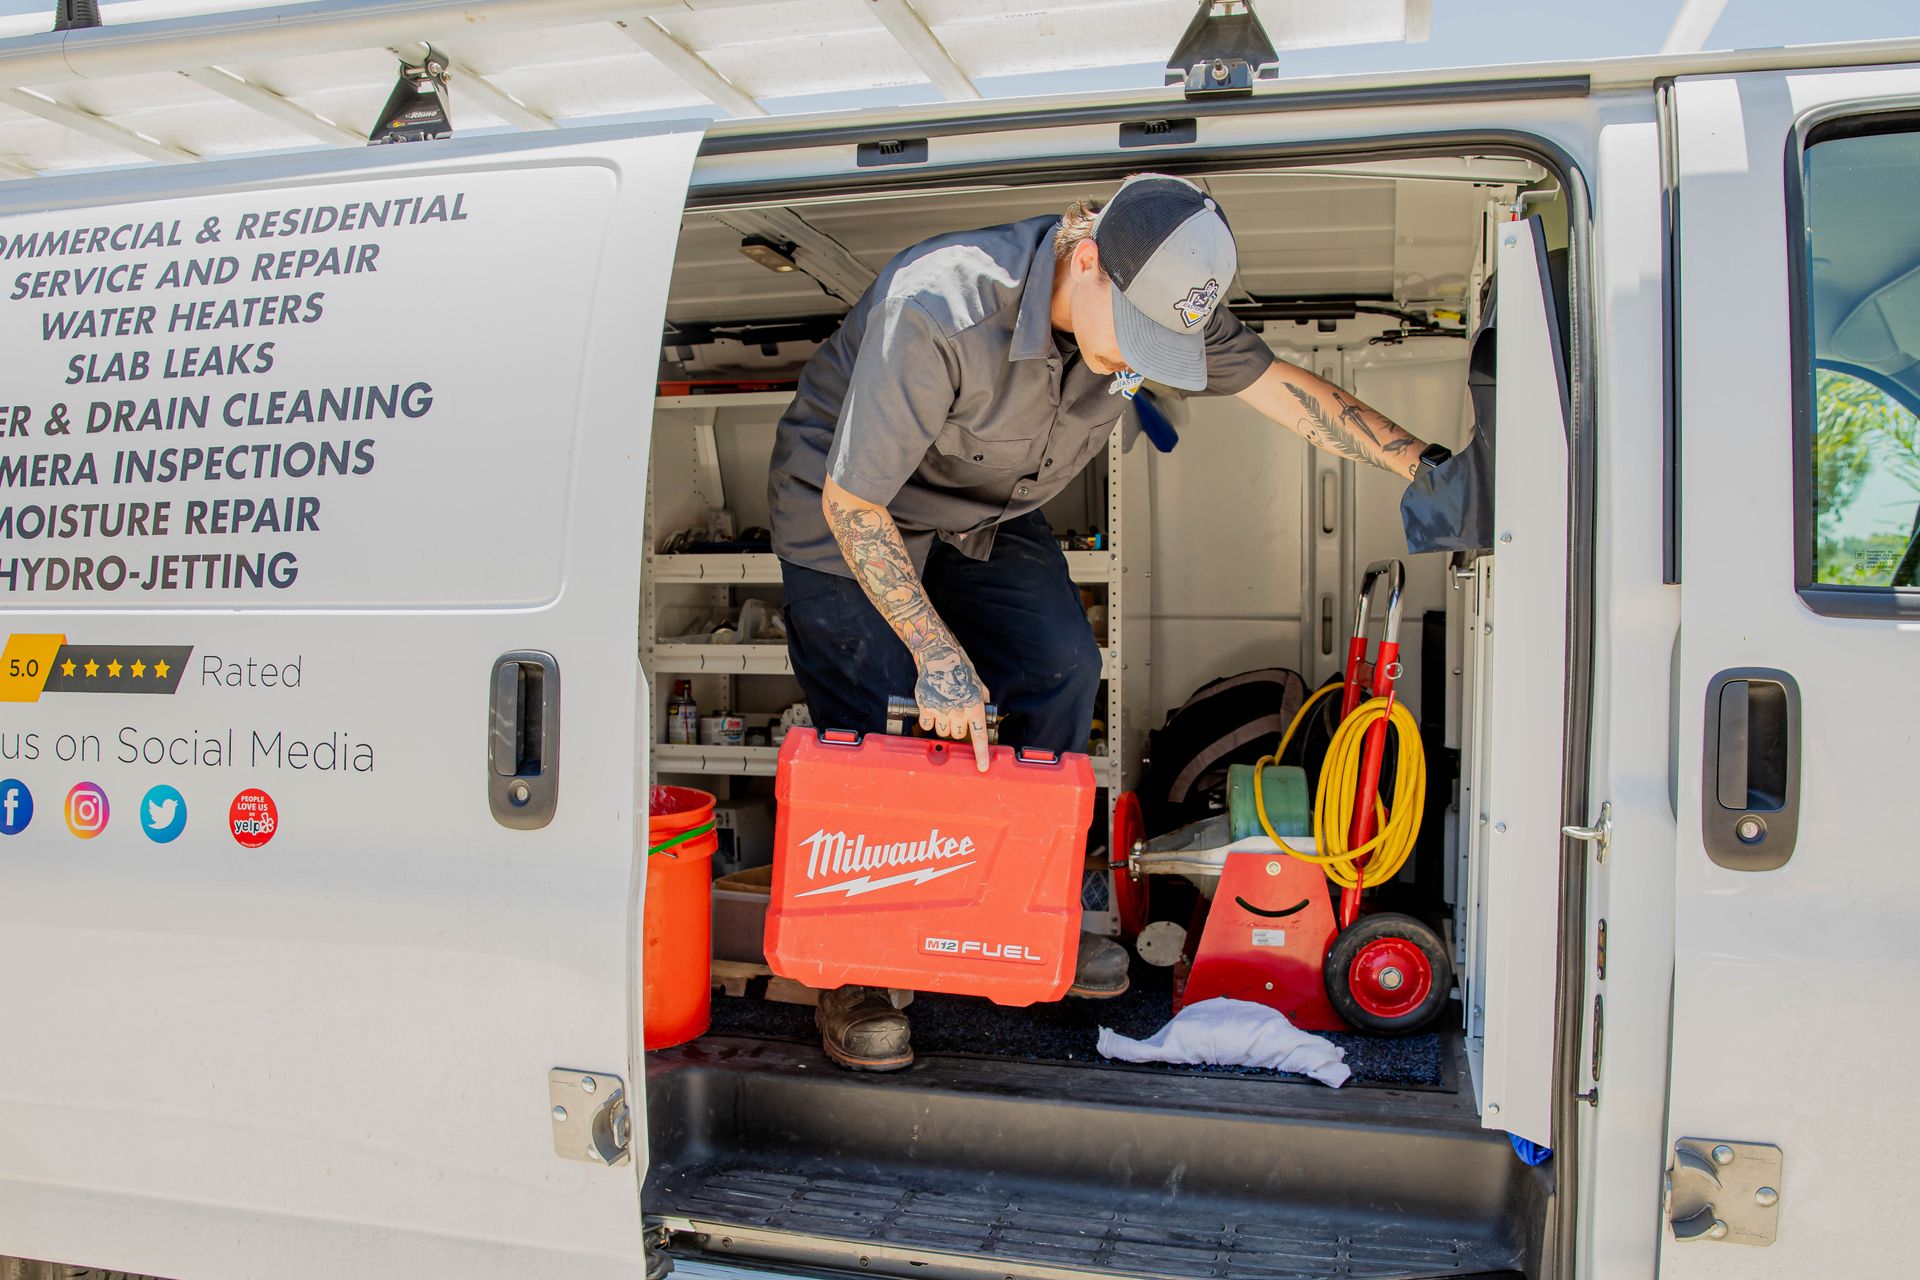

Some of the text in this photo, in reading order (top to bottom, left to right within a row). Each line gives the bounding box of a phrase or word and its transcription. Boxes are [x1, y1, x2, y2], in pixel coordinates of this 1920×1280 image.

[195, 216, 221, 244] &
[235, 192, 468, 241] RESIDENTIAL
[10, 243, 380, 301] SERVICE AND REPAIR
[42, 292, 325, 341] WATER HEATERS
[65, 341, 275, 385] SLAB LEAKS
[44, 402, 71, 436] &
[86, 396, 210, 434] DRAIN
[222, 382, 433, 428] CLEANING
[0, 438, 376, 488] MERA INSPECTIONS
[184, 496, 321, 535] REPAIR
[0, 551, 299, 592] HYDRO-JETTING
[9, 655, 302, 688] 5.0 Rated
[2, 726, 375, 772] us on Social Media
[237, 802, 268, 812] LOVE US
[240, 795, 265, 803] PEOPLE
[234, 818, 261, 836] yelp
[799, 828, 976, 880] Milwaukee
[927, 940, 1041, 961] M12 FUEL
